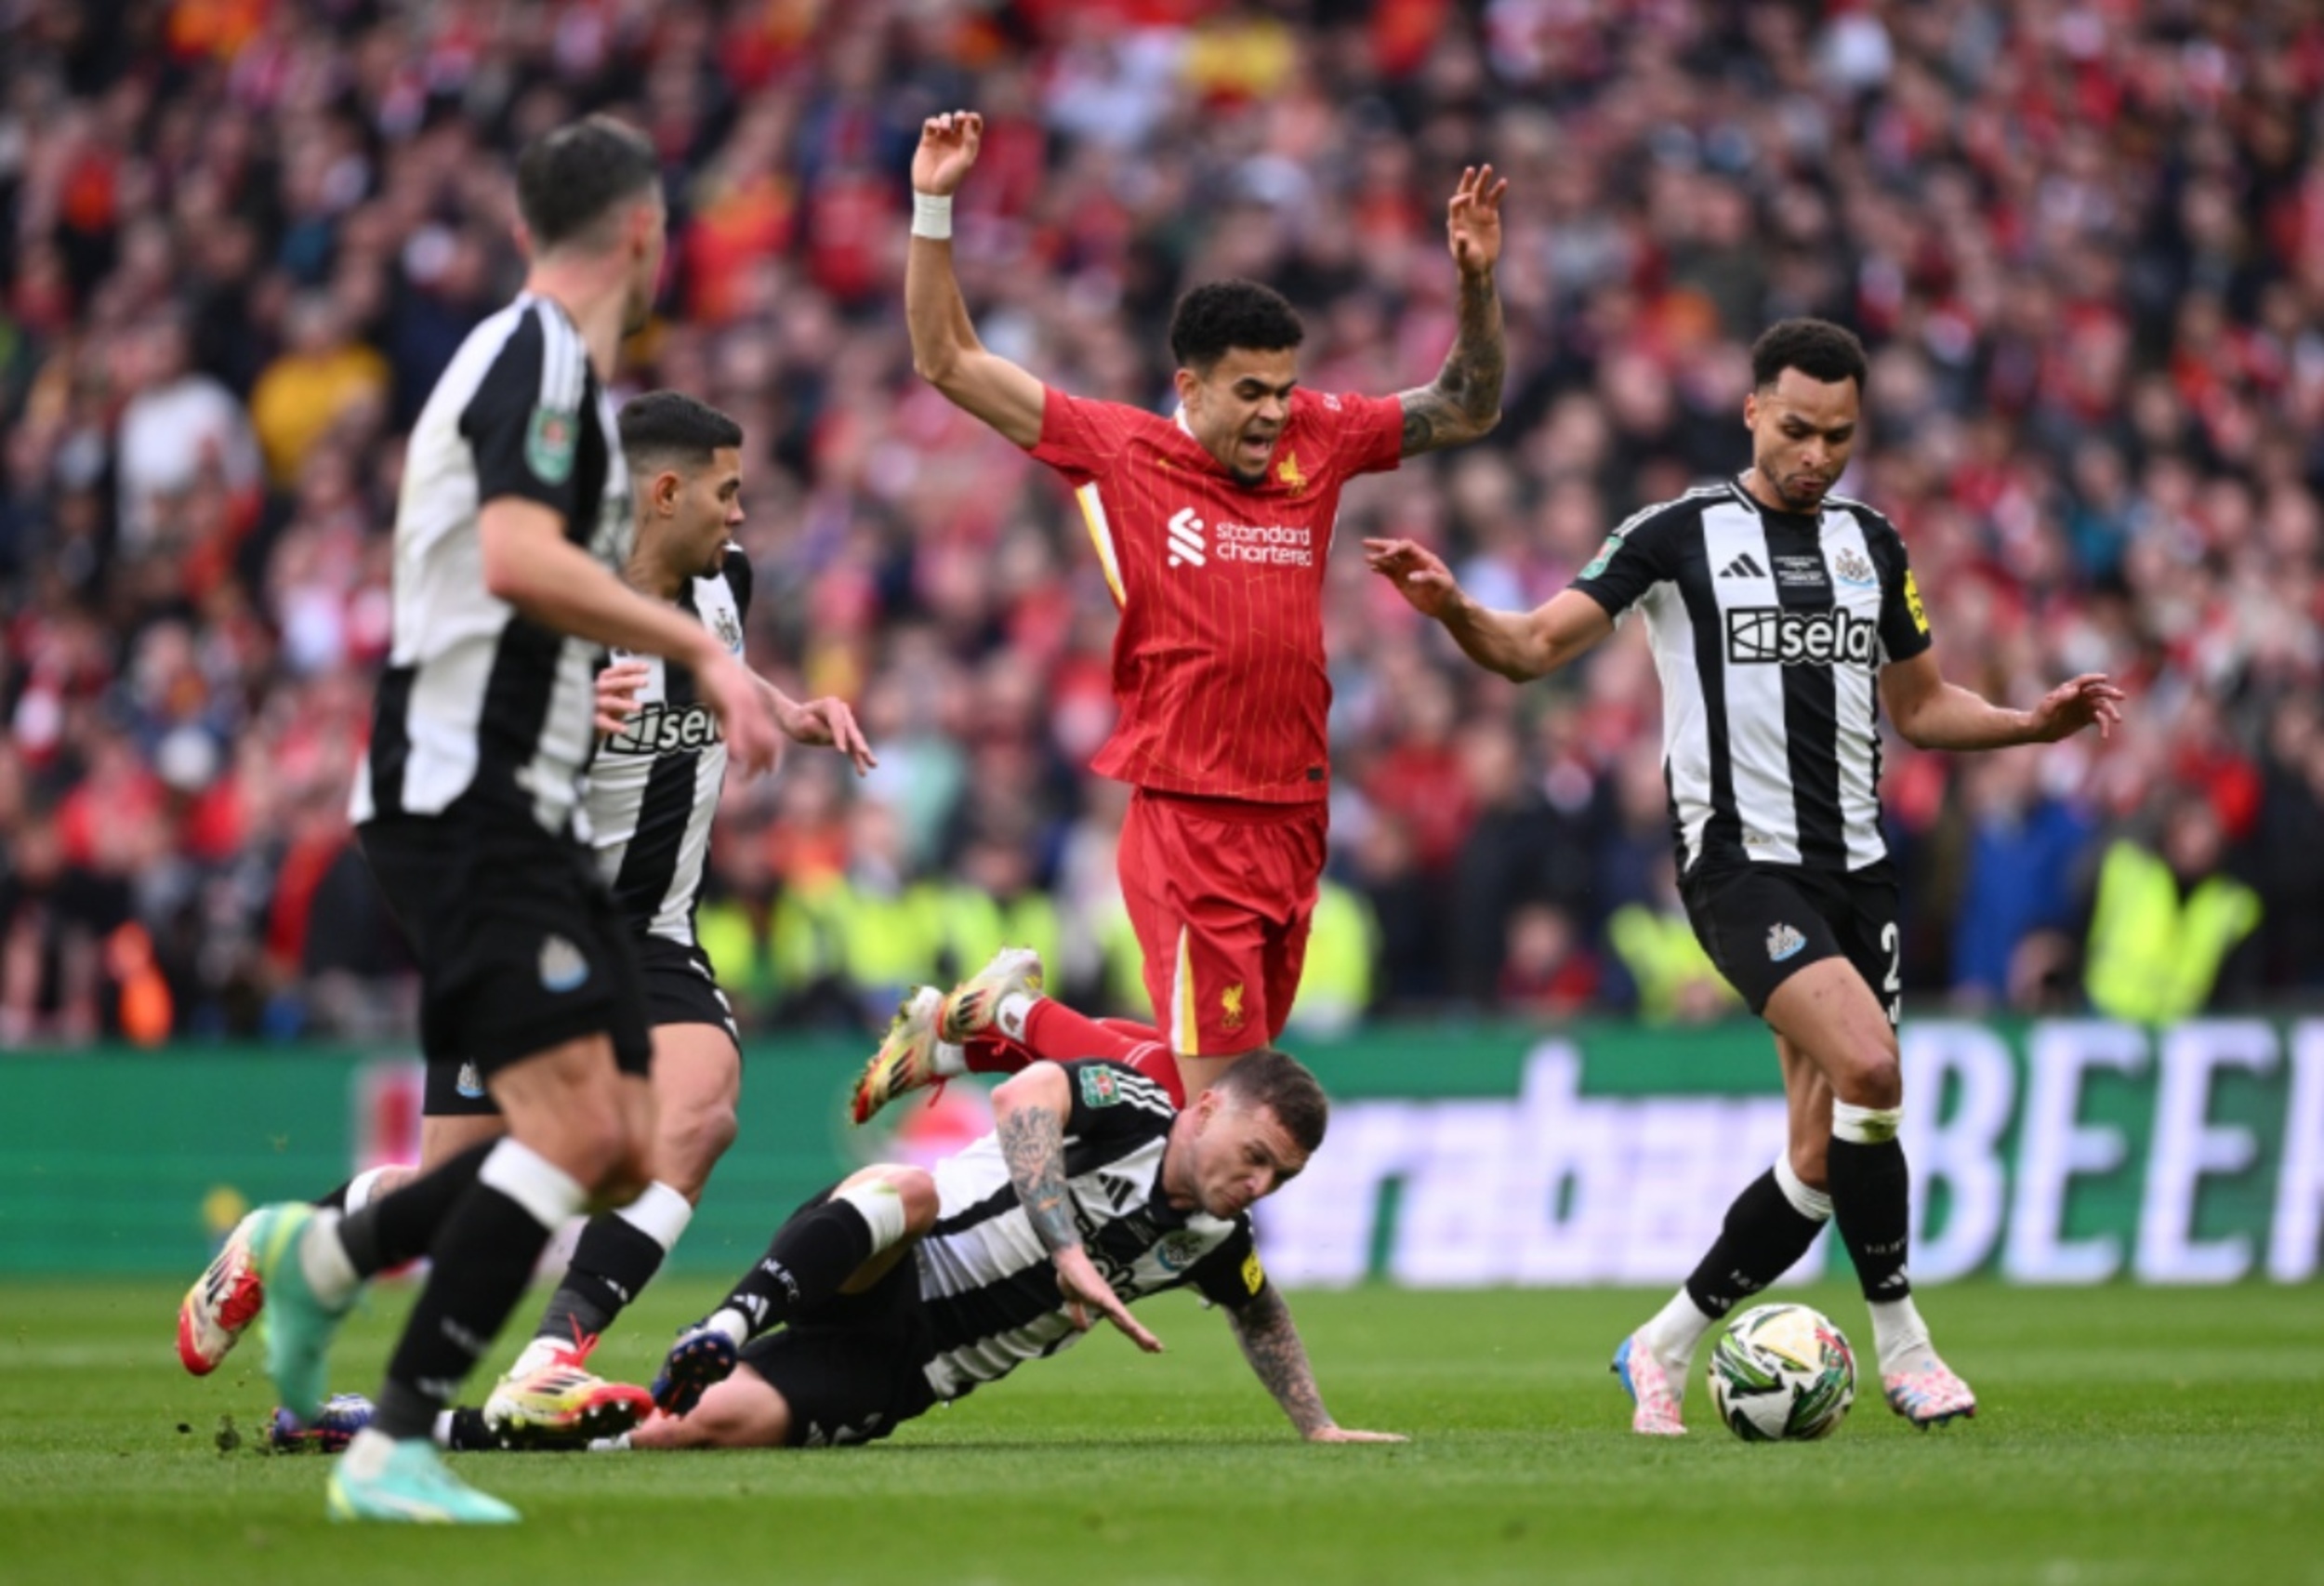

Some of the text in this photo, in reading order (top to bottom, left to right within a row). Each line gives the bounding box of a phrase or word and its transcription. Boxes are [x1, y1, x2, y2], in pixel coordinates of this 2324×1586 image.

[1216, 522, 1310, 546] standard
[1216, 541, 1313, 566] chartered
[1779, 610, 1874, 661] sela
[657, 707, 719, 749] sel
